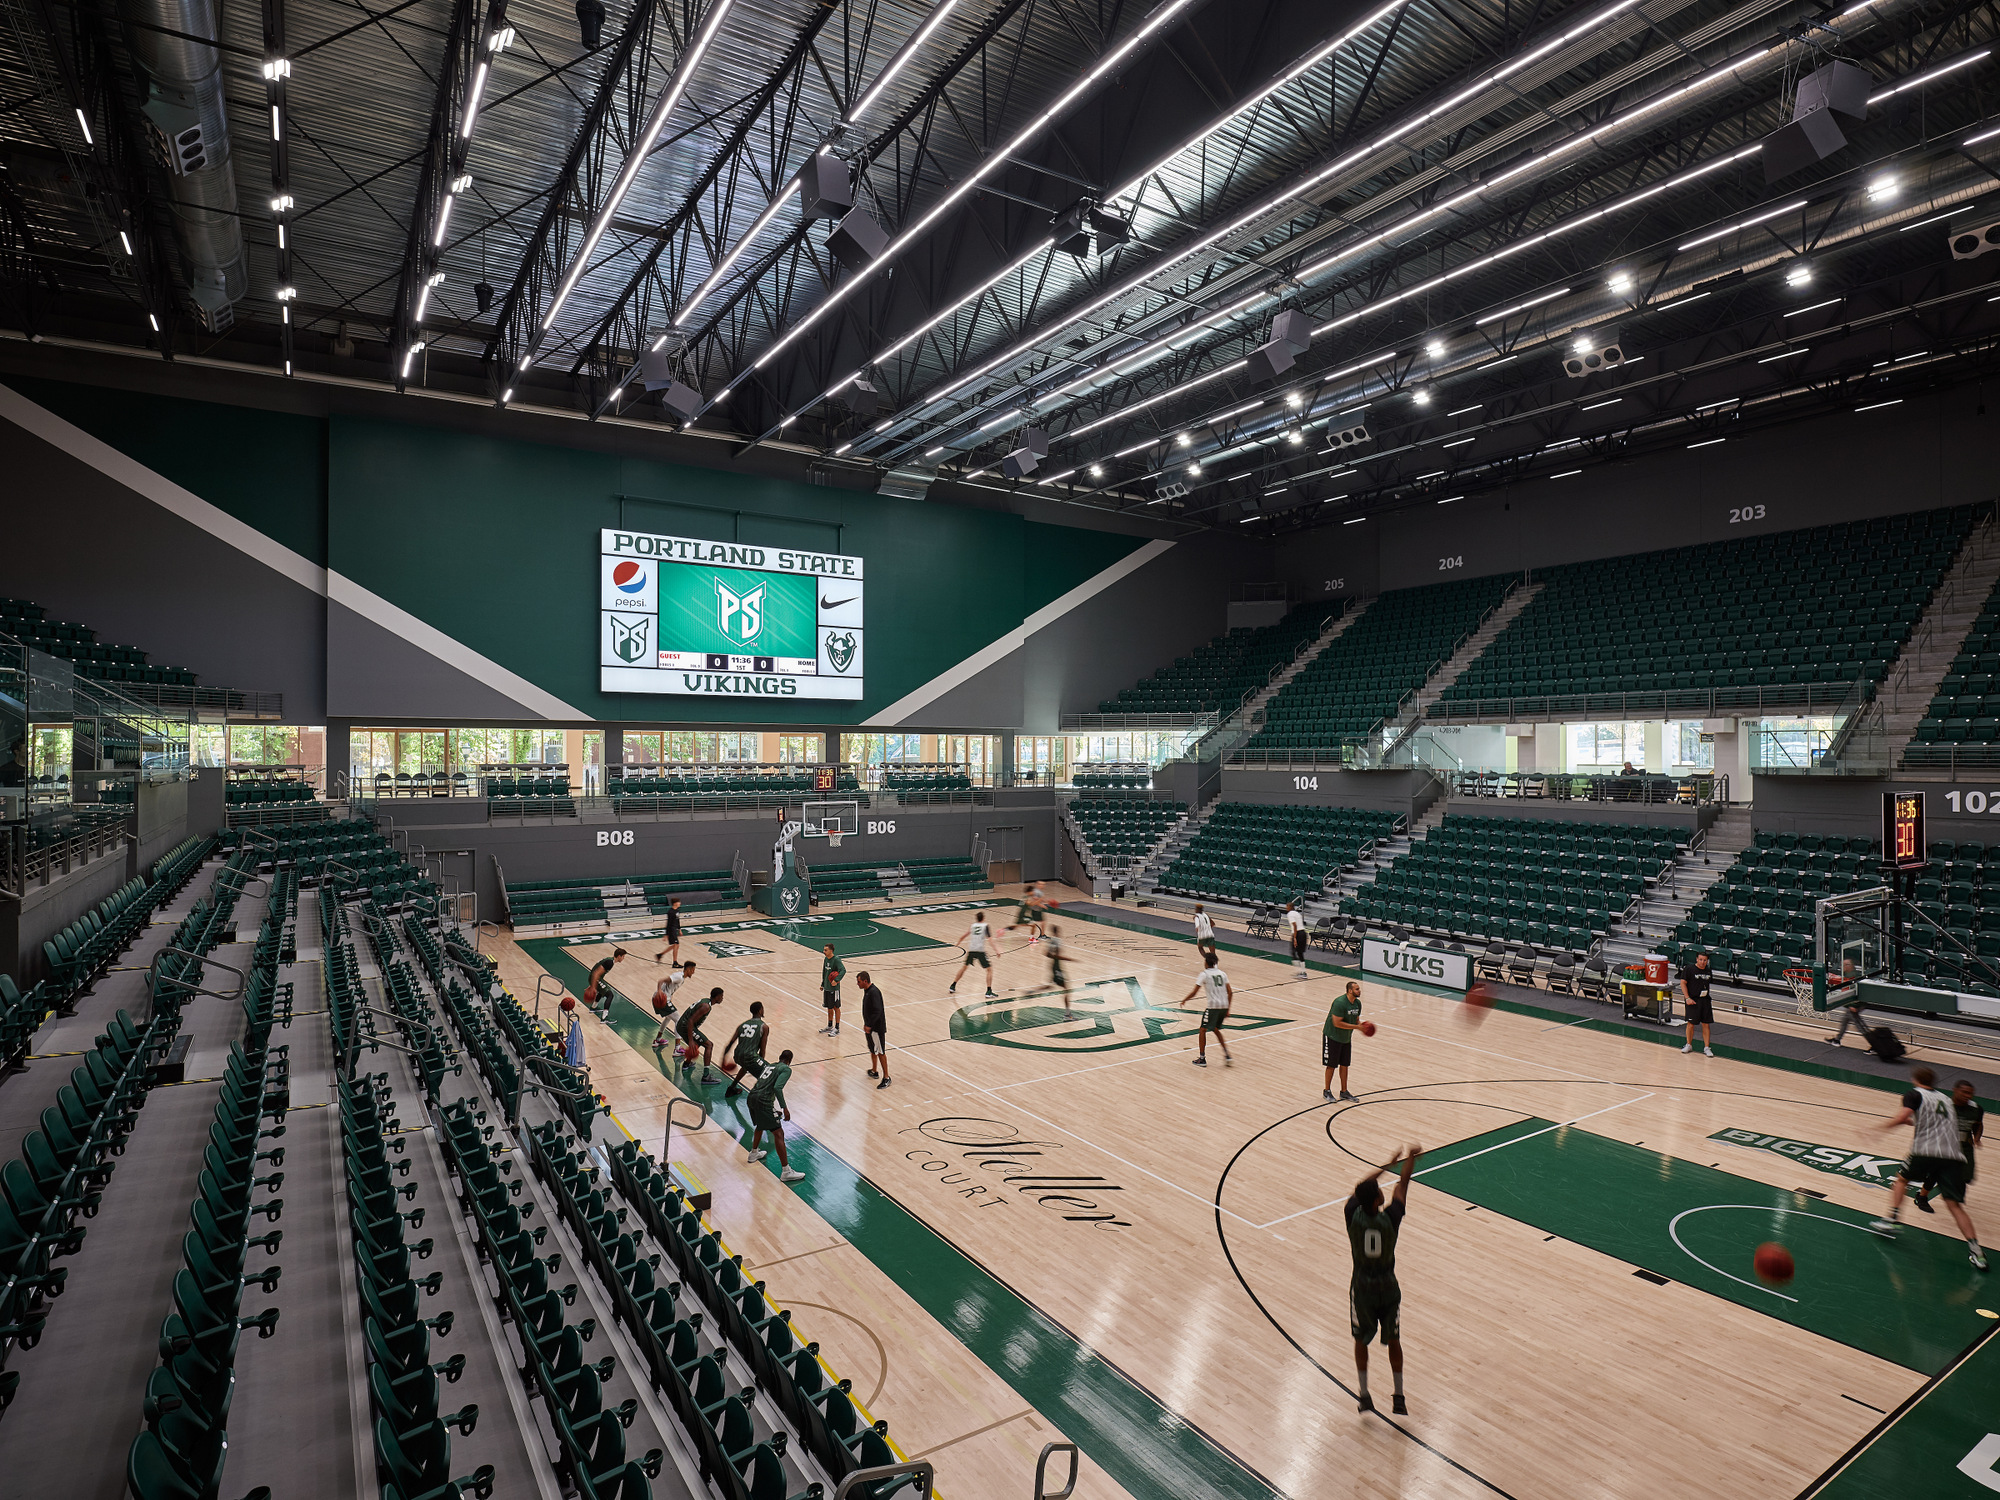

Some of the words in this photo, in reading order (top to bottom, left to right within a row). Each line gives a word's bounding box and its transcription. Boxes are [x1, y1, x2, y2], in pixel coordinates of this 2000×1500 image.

[1729, 504, 1766, 524] 203
[613, 533, 766, 567] PORTLAND
[778, 552, 855, 576] STATE
[1438, 555, 1464, 571] 204
[1324, 578, 1345, 592] 205
[714, 657, 721, 667] 0
[731, 656, 752, 664] 11:36
[760, 660, 767, 669] 0
[683, 673, 797, 695] VIKINGS
[818, 776, 832, 789] 30
[1292, 776, 1319, 790] 104
[867, 820, 896, 835] B06
[596, 830, 635, 847] B08
[1897, 822, 1915, 857] 30
[1382, 949, 1445, 979] VIKS
[1648, 964, 1656, 972] G
[1212, 974, 1224, 988] 10
[739, 1023, 758, 1038] 35
[760, 1065, 776, 1080] 15
[905, 1150, 1009, 1208] COURT
[1364, 1228, 1382, 1259] 0
